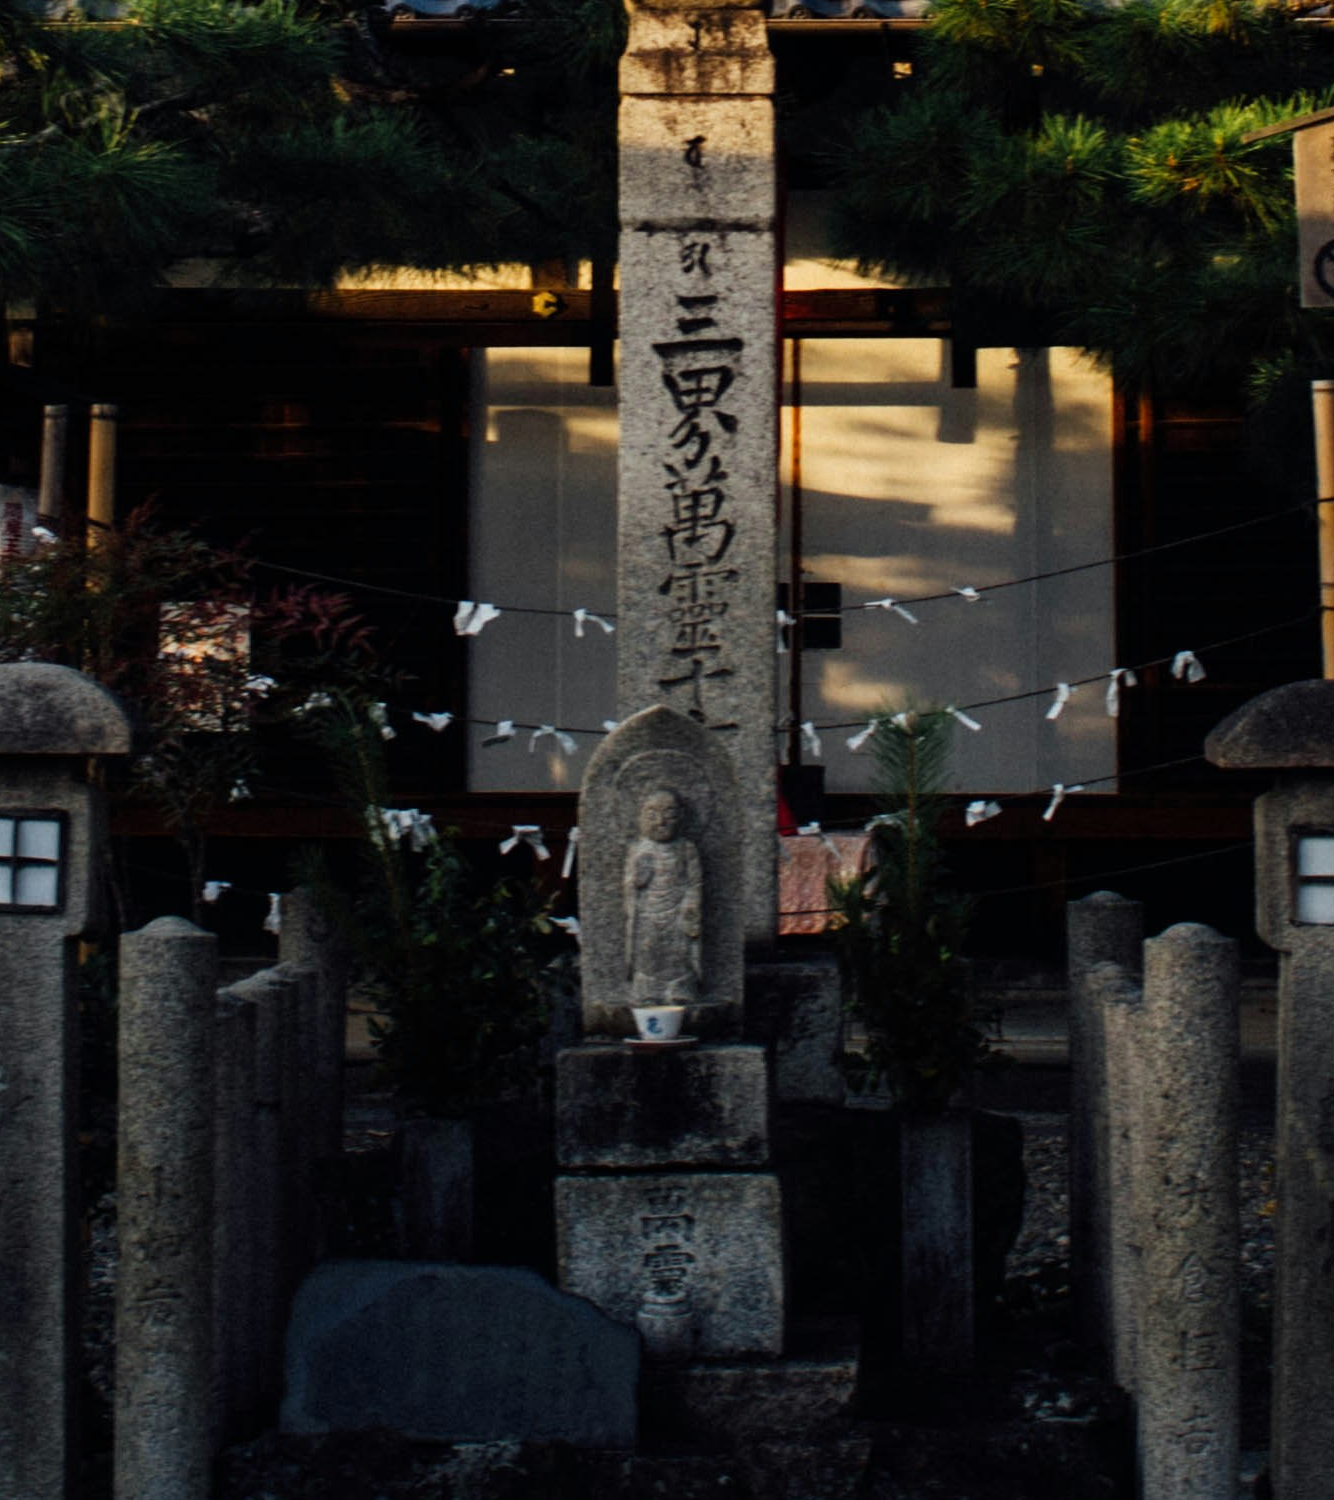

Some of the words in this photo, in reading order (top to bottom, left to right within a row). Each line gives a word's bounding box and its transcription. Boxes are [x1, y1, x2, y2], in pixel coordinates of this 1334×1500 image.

[652, 294, 744, 731] 三界萬靈十
